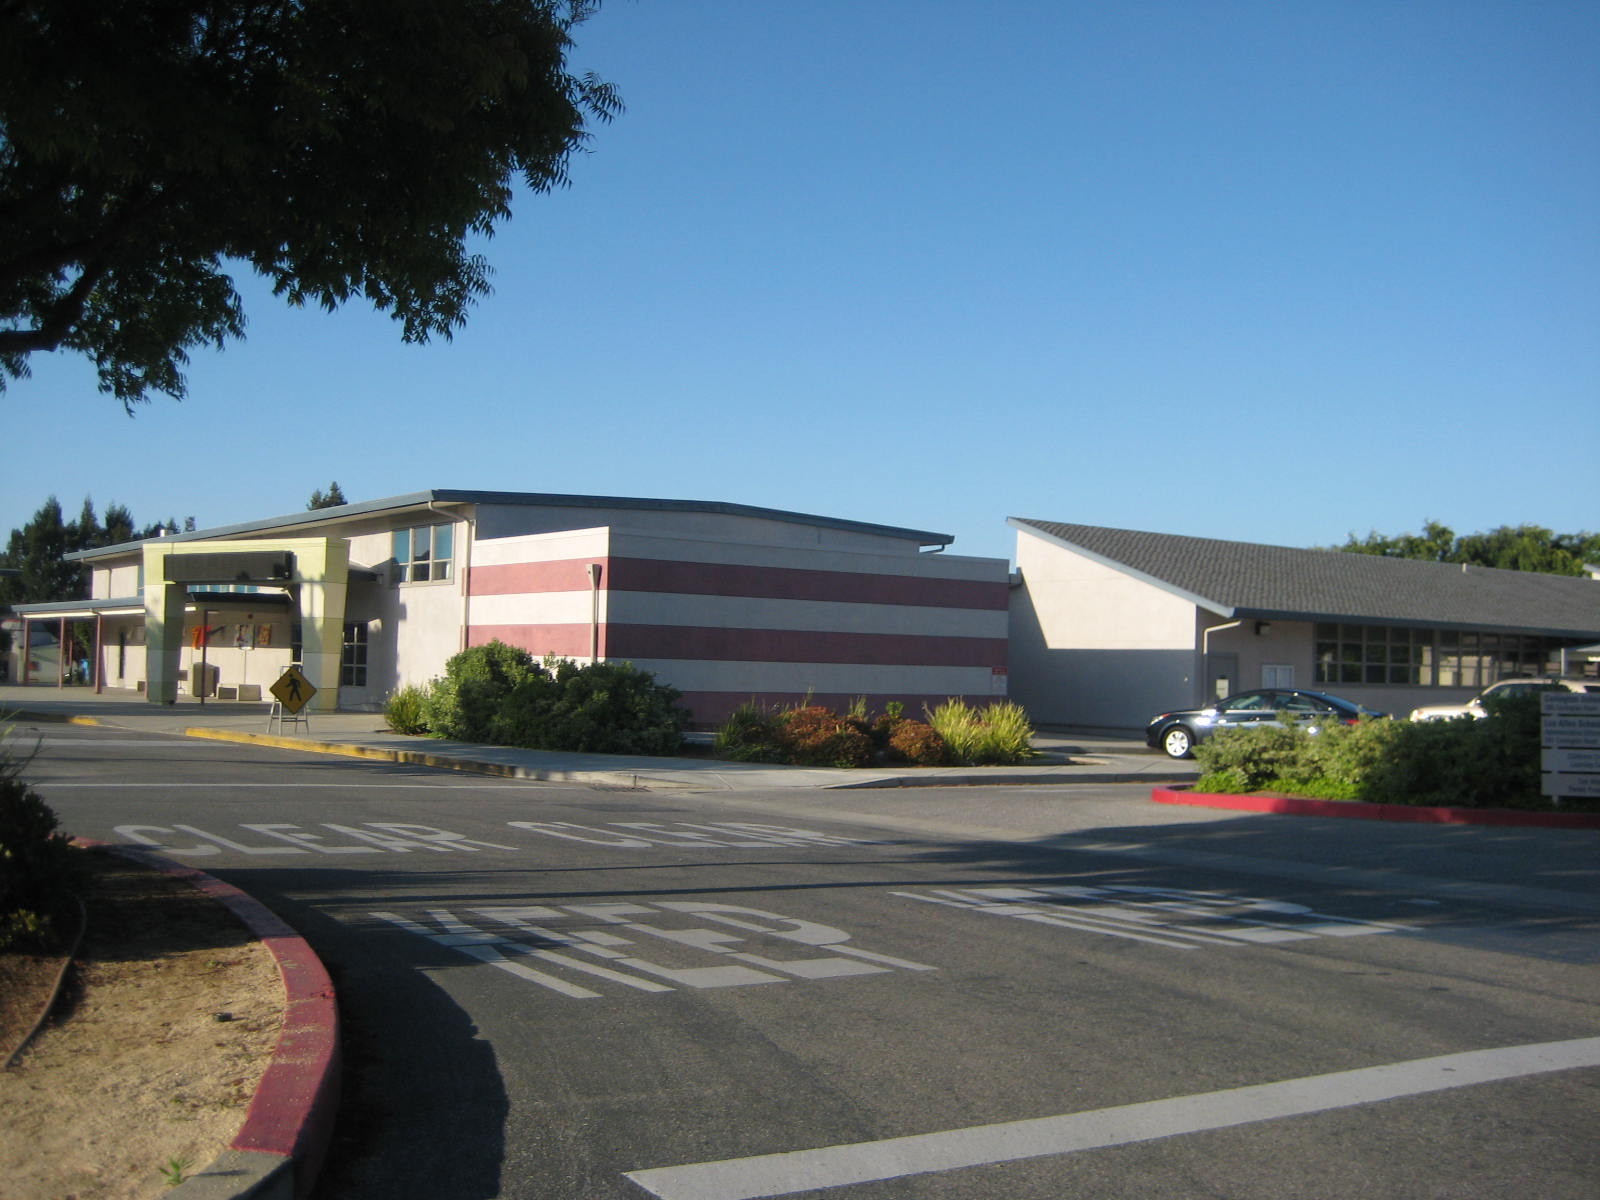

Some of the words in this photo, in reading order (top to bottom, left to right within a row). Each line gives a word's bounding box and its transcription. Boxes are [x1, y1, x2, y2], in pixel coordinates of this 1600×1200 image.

[113, 822, 520, 856] CLEAR
[507, 821, 888, 848] CLEAR
[889, 886, 1425, 949] KEEP
[369, 901, 938, 999] KEEP
